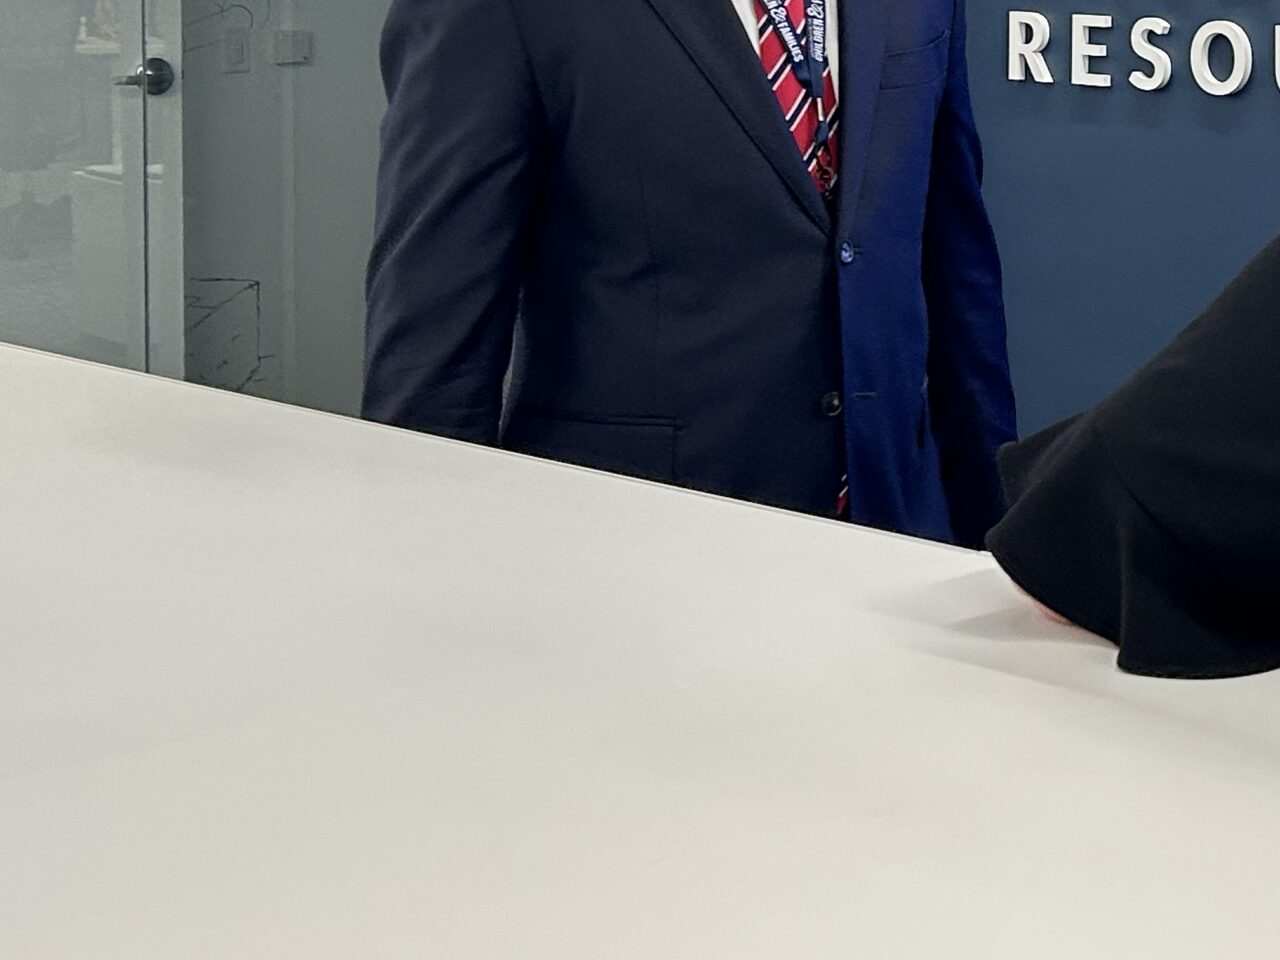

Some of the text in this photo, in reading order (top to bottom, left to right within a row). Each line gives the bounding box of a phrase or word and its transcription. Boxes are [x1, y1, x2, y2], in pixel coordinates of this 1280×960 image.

[769, 7, 787, 23] &
[807, 3, 824, 18] &
[777, 22, 804, 63] FAMILIES
[812, 18, 824, 62] CHILDREN
